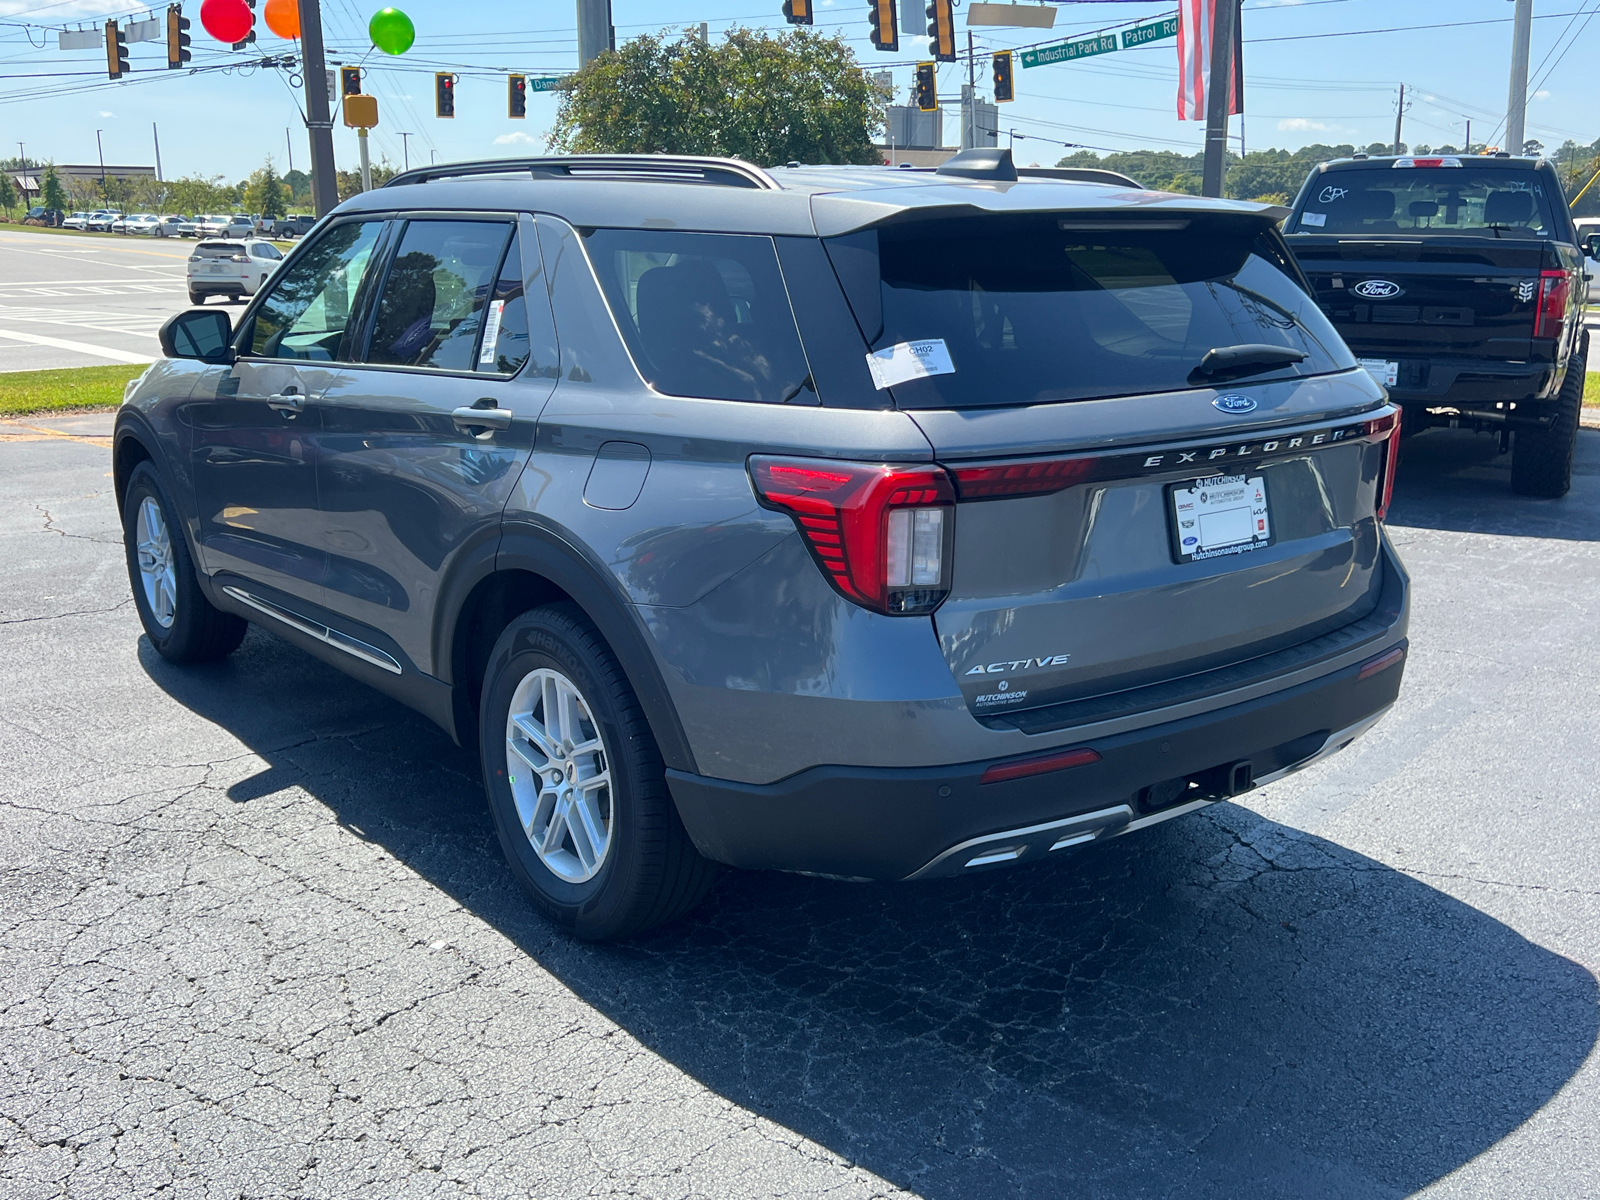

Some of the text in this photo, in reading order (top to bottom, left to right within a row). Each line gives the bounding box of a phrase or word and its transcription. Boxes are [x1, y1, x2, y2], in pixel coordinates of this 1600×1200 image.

[1125, 20, 1177, 45] Patrol Rd
[1037, 38, 1113, 63] Industrial Park Rd
[534, 79, 561, 90] Dame
[1361, 282, 1393, 295] Ford
[908, 345, 934, 355] CH02
[1223, 396, 1251, 408] Ford
[1143, 430, 1346, 468] EXPLORER
[1204, 475, 1246, 487] HUTCHINSON
[1191, 540, 1268, 561] Hutchinsonautogroup.com
[965, 654, 1071, 676] ACTIVE
[976, 690, 1028, 702] HUTCHINSON
